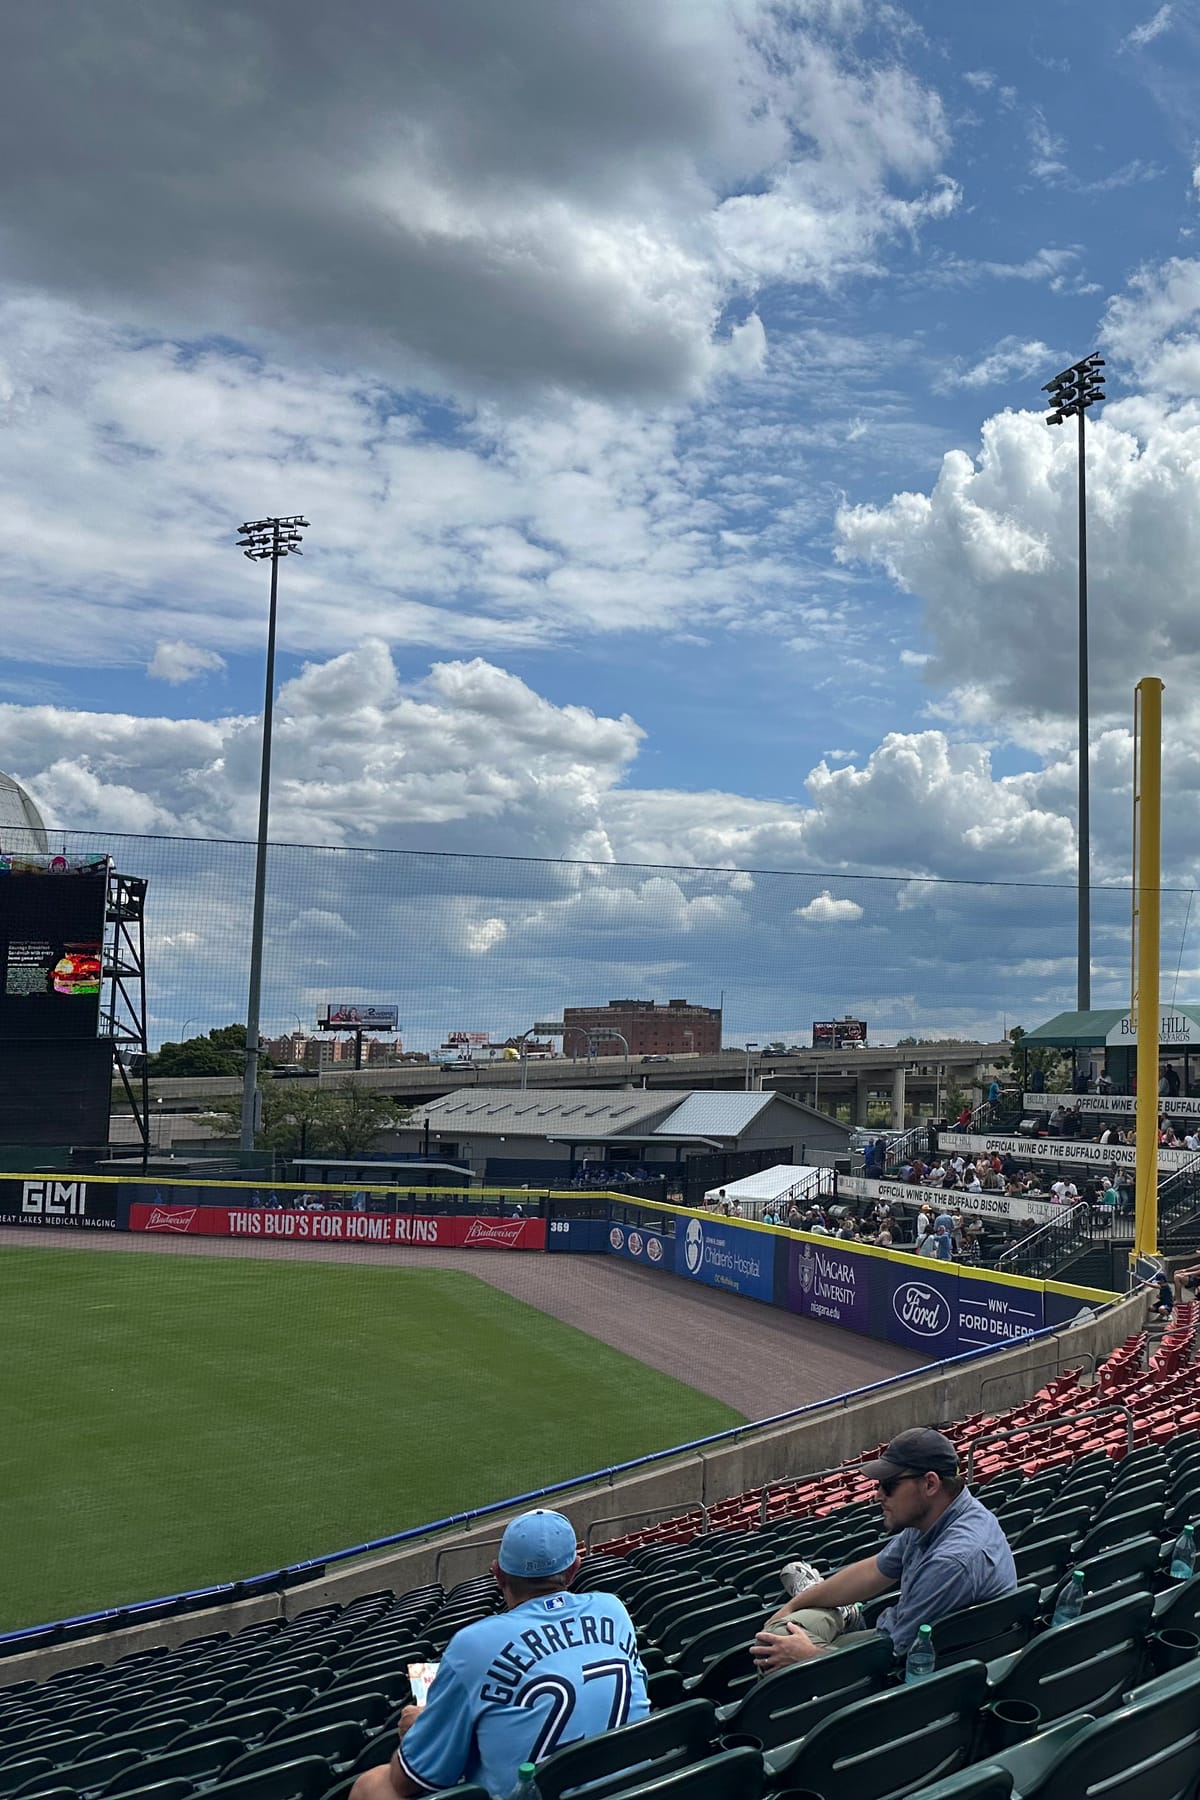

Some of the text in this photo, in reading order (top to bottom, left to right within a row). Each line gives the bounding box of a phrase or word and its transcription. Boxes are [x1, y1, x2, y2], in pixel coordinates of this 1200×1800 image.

[1161, 1017, 1190, 1033] HILL
[1158, 1033, 1190, 1042] NEYARDS
[1076, 1098, 1109, 1109] OFFICIAL
[1111, 1099, 1132, 1111] WINE
[985, 1140, 1135, 1163] OFFICIAL WINE OF THE BUFFALO BISONS!
[878, 1185, 905, 1198] OFFICIAL
[906, 1189, 923, 1201] WINE
[923, 1191, 932, 1202] OF
[933, 1193, 947, 1204] THE
[948, 1194, 979, 1210] BUFFALO
[980, 1199, 1010, 1214] BISONS!
[0, 1214, 116, 1228] EAT LAKES MEDICAL IMAGING
[151, 1213, 191, 1225] Budweiser
[228, 1212, 438, 1242] THIS BUD'S FOR HOME RUNS
[550, 1222, 570, 1232] 369
[470, 1225, 519, 1238] Budweiser
[815, 1252, 855, 1285] NIAGARA
[814, 1275, 856, 1306] UNIVERSITY
[810, 1300, 840, 1320] niagara.edu
[902, 1287, 940, 1330] Ford
[988, 1298, 1008, 1314] WNY
[959, 1313, 988, 1331] FORD
[480, 1615, 614, 1705] GUERRERO
[514, 1658, 632, 1765] 27
